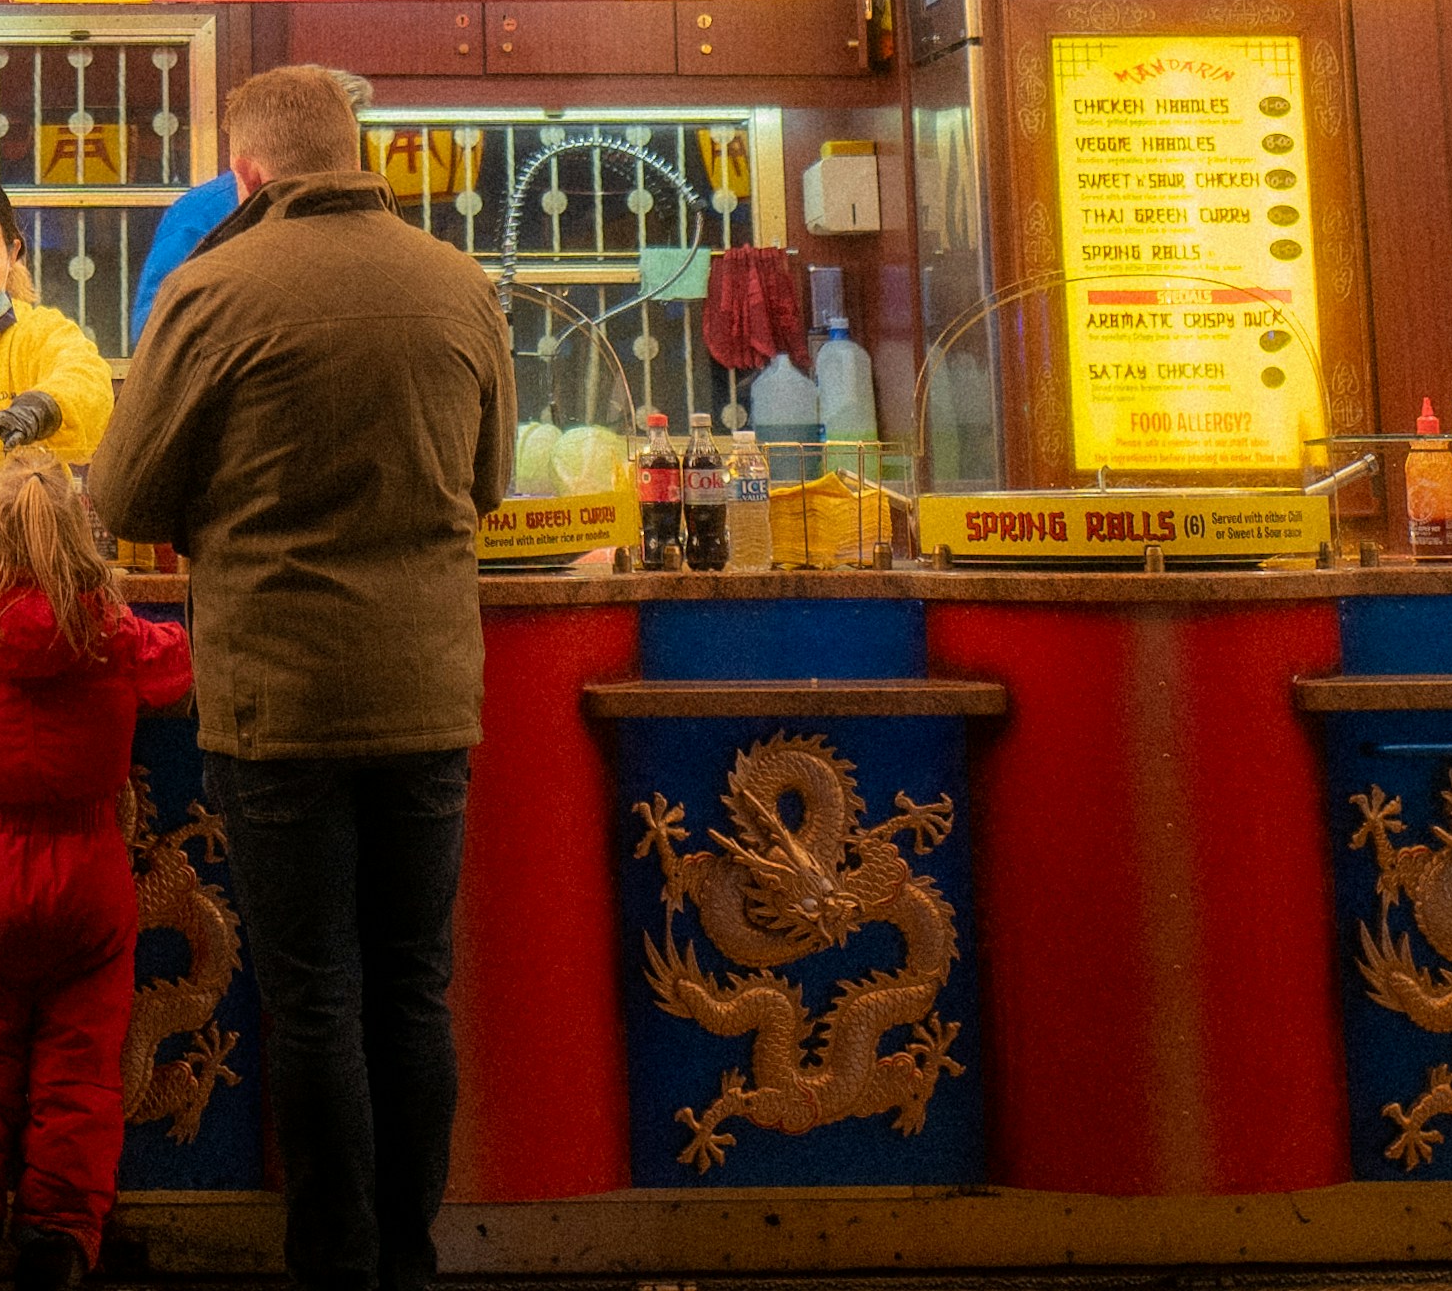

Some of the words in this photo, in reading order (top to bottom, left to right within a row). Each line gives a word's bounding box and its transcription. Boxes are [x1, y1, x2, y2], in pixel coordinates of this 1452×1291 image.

[1113, 58, 1236, 85] MANDARIN
[1073, 98, 1144, 115] CHICKEN
[1156, 98, 1229, 115] NOODLES
[1076, 136, 1132, 153] VEGGIE
[1142, 135, 1216, 152] NOODLES
[1078, 173, 1131, 189] SWEET
[1149, 173, 1185, 189] SOUR
[1195, 172, 1261, 188] CHICKEN
[1081, 208, 1124, 224] THAI
[1135, 208, 1188, 225] GREEN
[1199, 207, 1251, 224] CURRY
[1082, 244, 1141, 261] SPRING
[1152, 244, 1201, 261] ROLLS
[1086, 312, 1173, 329] AROMATIC
[1183, 312, 1236, 329] CRISPY
[1244, 308, 1287, 327] DUCK
[1088, 363, 1147, 381] SATAY
[1158, 363, 1225, 380] CHICKEN
[1131, 412, 1172, 433] FOOD
[1177, 411, 1252, 433] ALLERGY?
[741, 480, 767, 494] ICE
[478, 512, 517, 532] THAI
[525, 509, 572, 530] GREEN
[580, 506, 616, 525] CURRY
[966, 510, 1068, 543] SPRING
[1085, 510, 1176, 543] ROLLS
[1184, 513, 1205, 539] (6)
[1212, 512, 1242, 525] Served
[1244, 511, 1263, 524] with
[1264, 511, 1286, 523] either
[484, 536, 514, 548] Served
[516, 534, 535, 546] with
[536, 533, 559, 545] either
[560, 532, 574, 543] rice
[1216, 529, 1225, 540] or
[1227, 527, 1255, 539] Sweet
[1256, 526, 1263, 539] &
